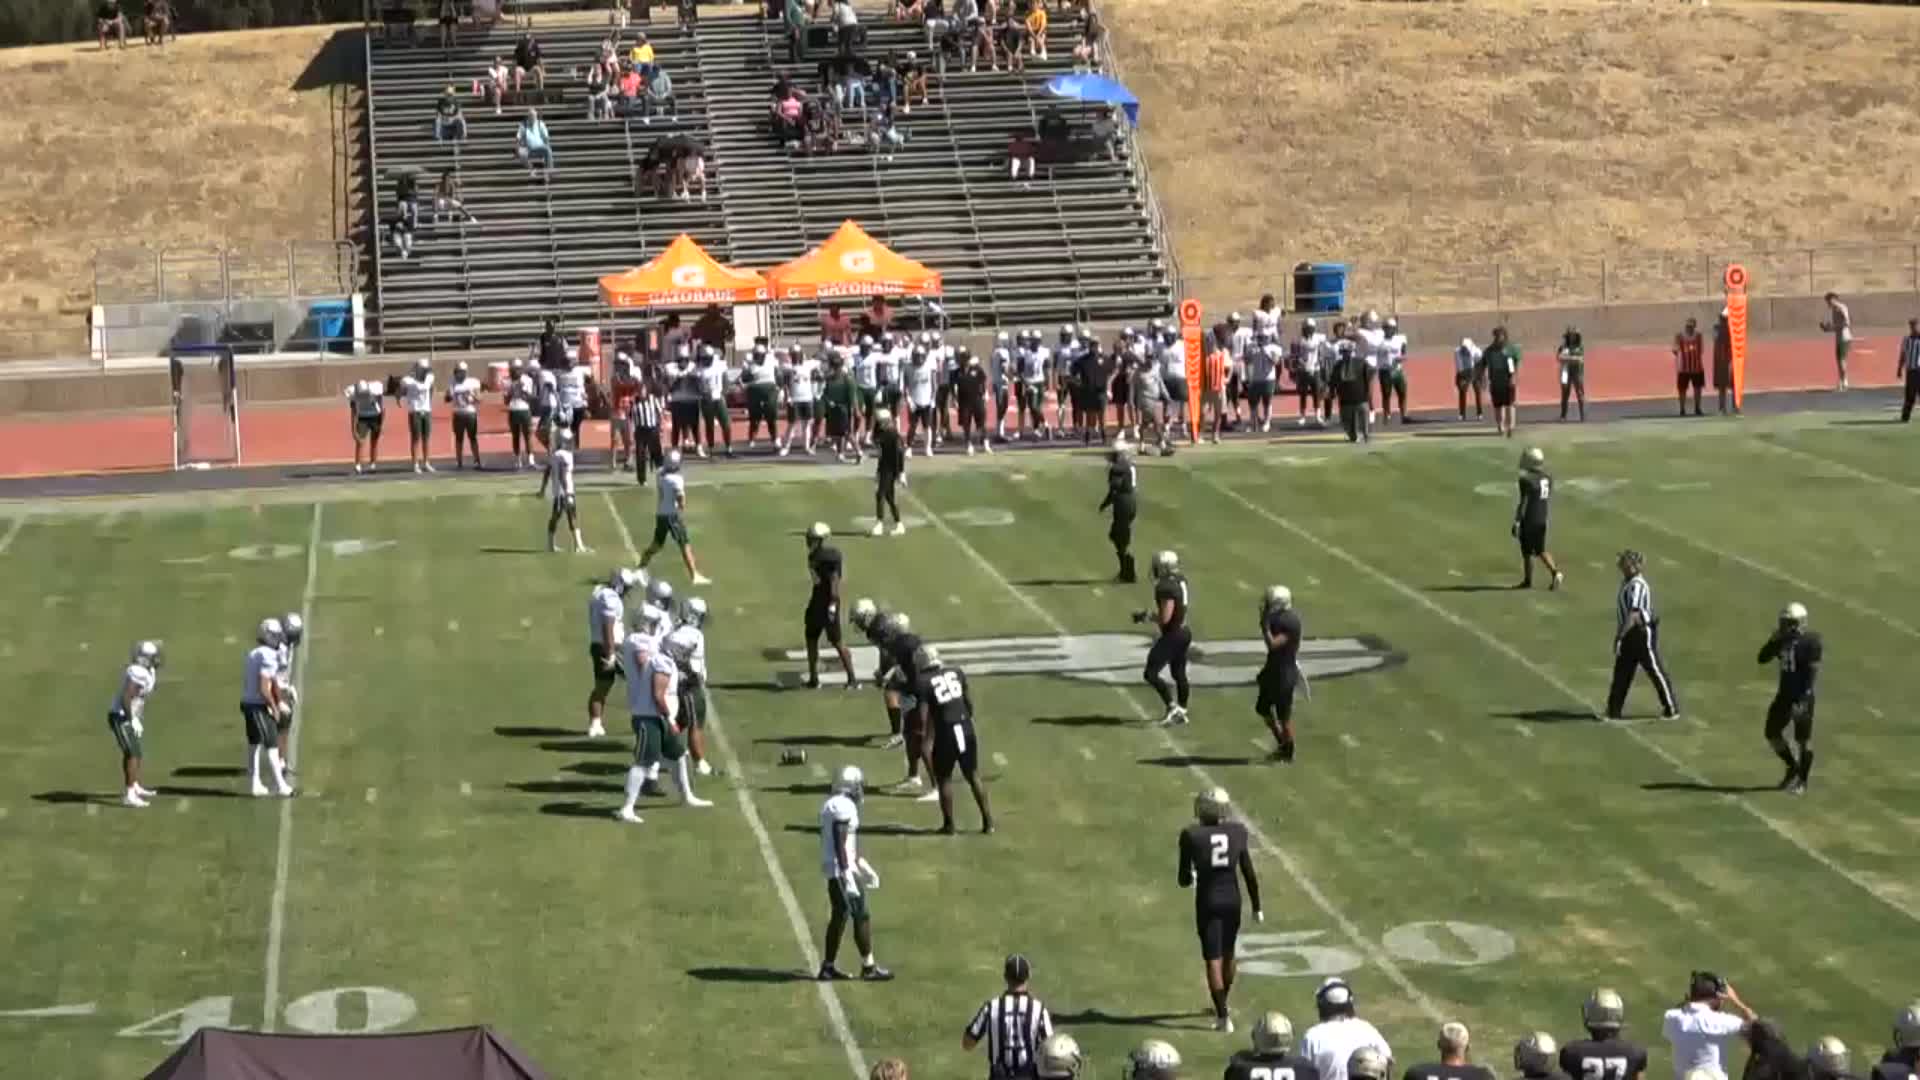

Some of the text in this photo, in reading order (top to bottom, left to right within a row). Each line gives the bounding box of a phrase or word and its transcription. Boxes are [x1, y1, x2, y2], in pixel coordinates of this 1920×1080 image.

[649, 287, 737, 305] GATORADE
[817, 280, 905, 297] GATORADE
[930, 671, 963, 704] 26
[1210, 833, 1229, 867] 2
[1235, 921, 1516, 977] 50
